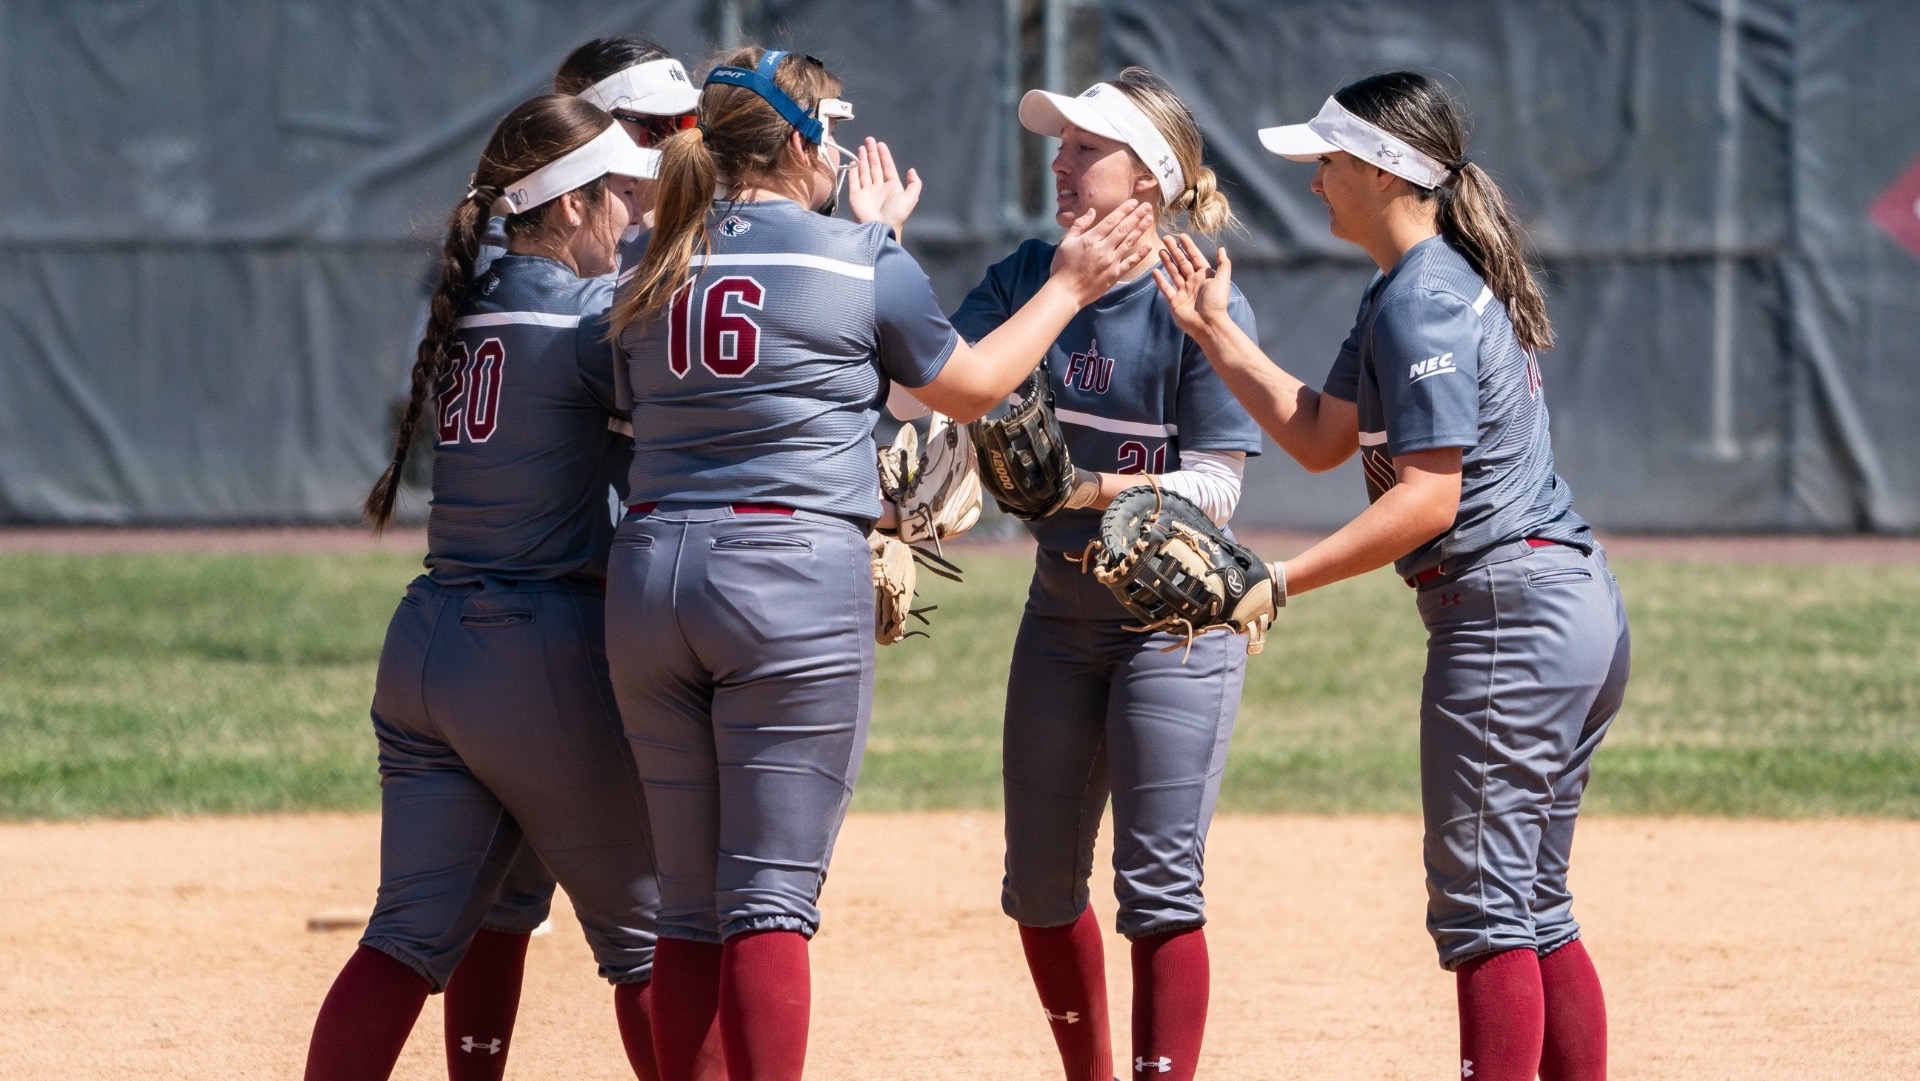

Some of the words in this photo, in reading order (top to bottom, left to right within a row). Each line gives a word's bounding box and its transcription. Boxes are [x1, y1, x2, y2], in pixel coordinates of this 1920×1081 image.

[510, 188, 529, 206] 20
[667, 273, 766, 380] 16
[1063, 346, 1115, 395] FDU
[1409, 352, 1454, 379] NEC
[437, 337, 505, 446] 20
[990, 449, 1015, 490] A2000
[1116, 440, 1168, 476] 21
